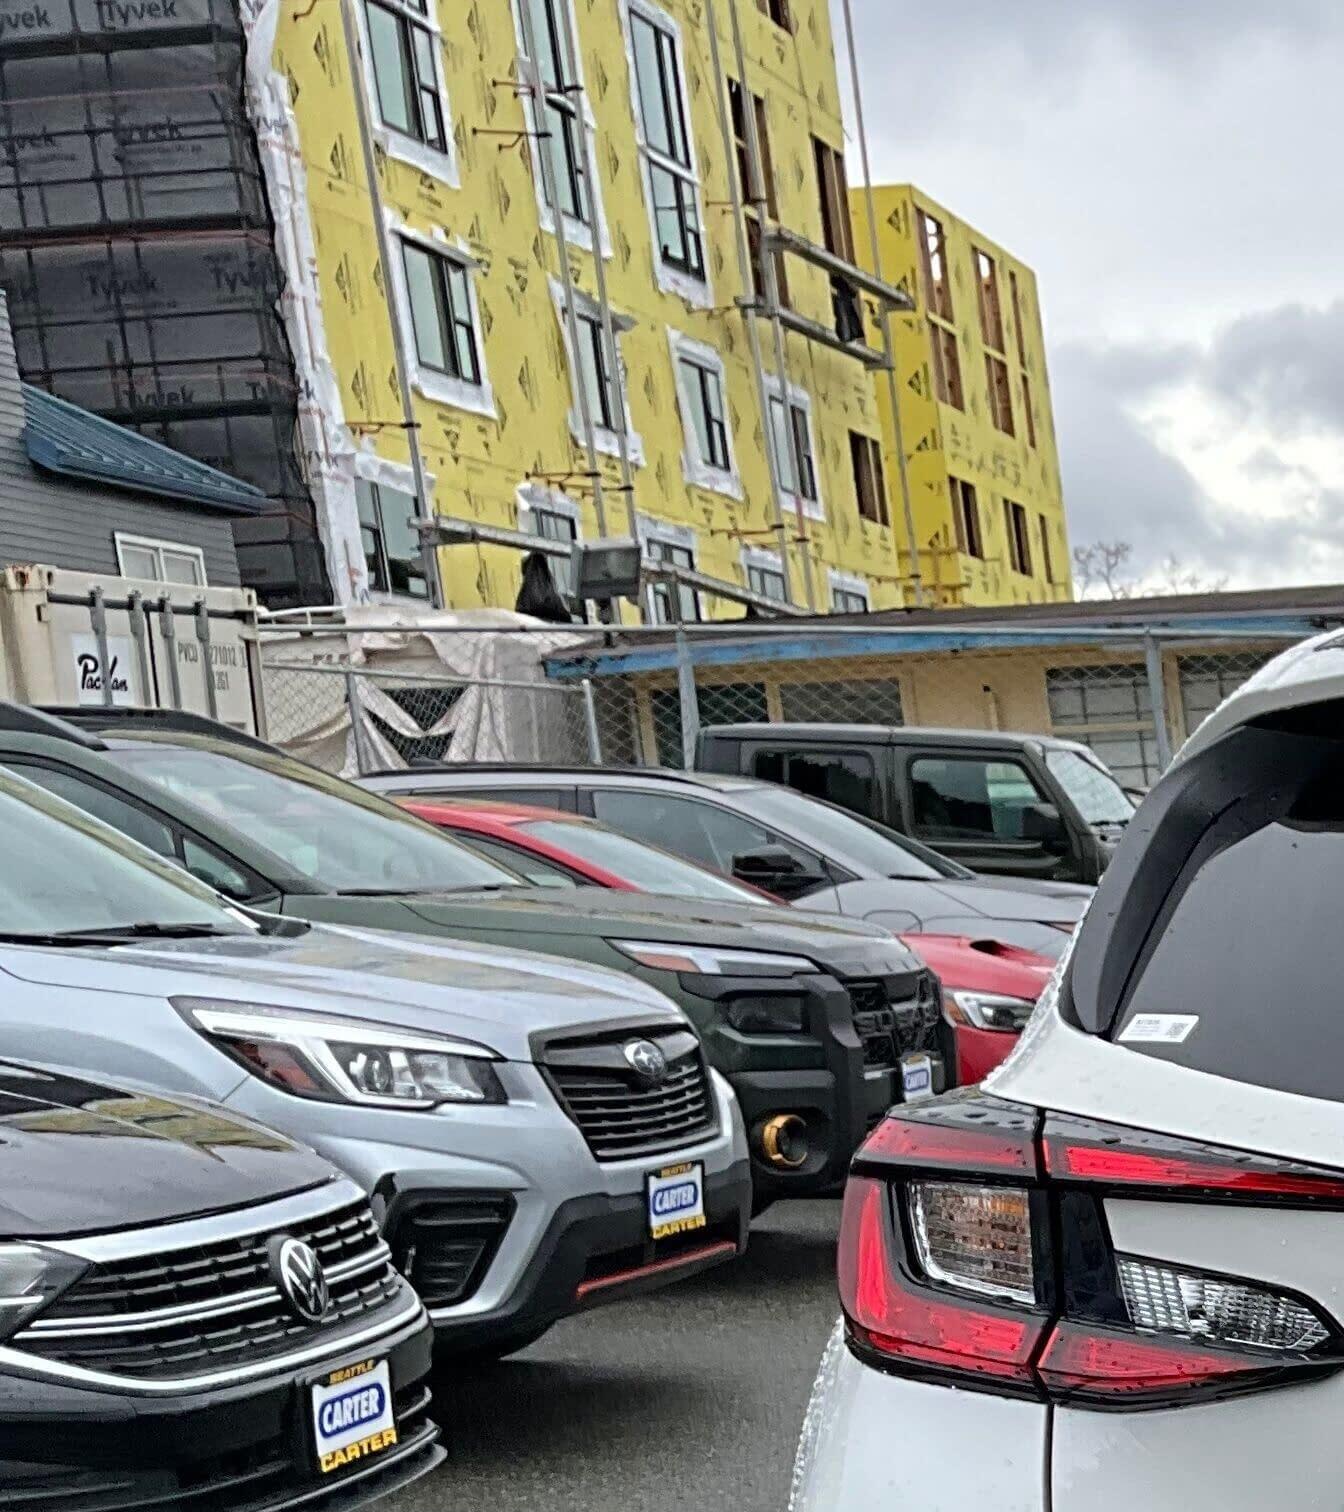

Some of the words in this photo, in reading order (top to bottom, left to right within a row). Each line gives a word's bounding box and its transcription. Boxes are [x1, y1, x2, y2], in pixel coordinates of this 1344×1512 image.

[656, 1185, 694, 1212] CARTER
[653, 1216, 706, 1239] CARTER
[322, 1387, 380, 1434] CARTER
[320, 1427, 397, 1473] CARTER
